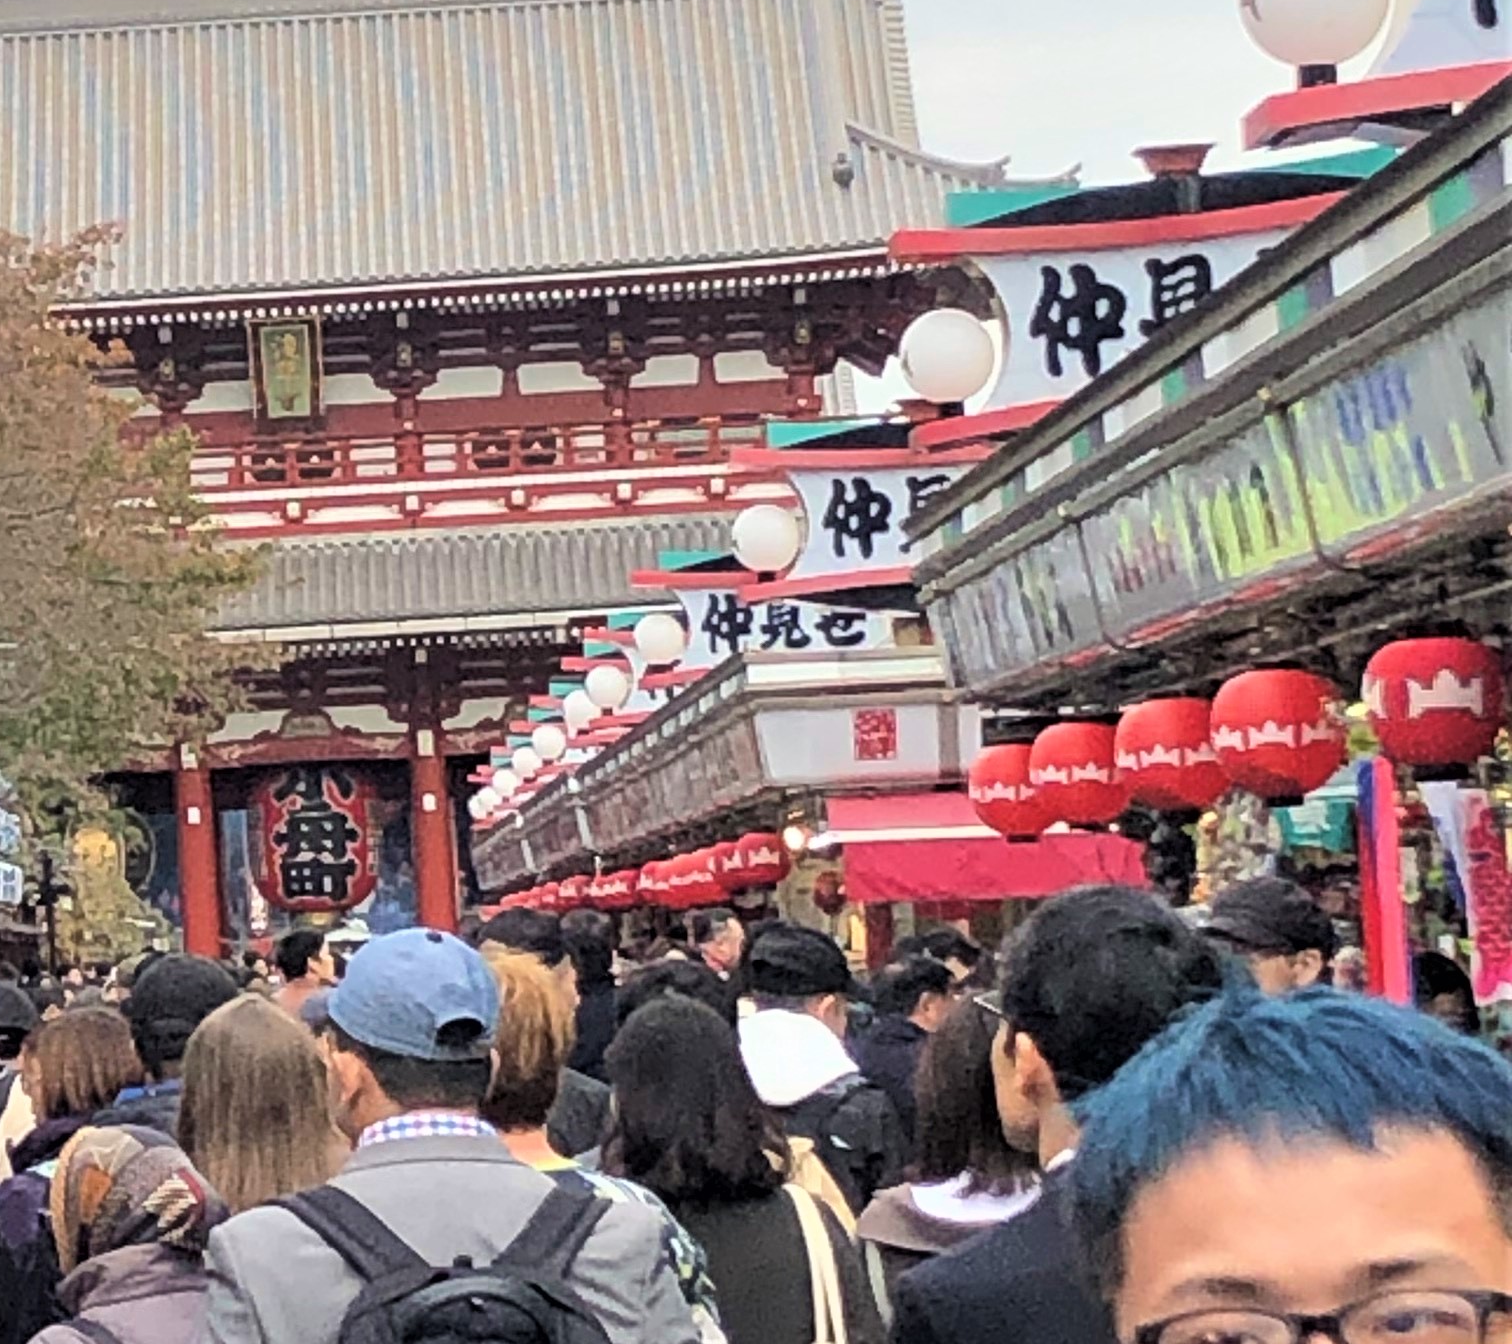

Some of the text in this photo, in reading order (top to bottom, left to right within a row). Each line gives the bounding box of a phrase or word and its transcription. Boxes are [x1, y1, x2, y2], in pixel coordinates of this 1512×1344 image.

[1029, 254, 1213, 378] 仲見
[272, 768, 360, 902] 小舟町
